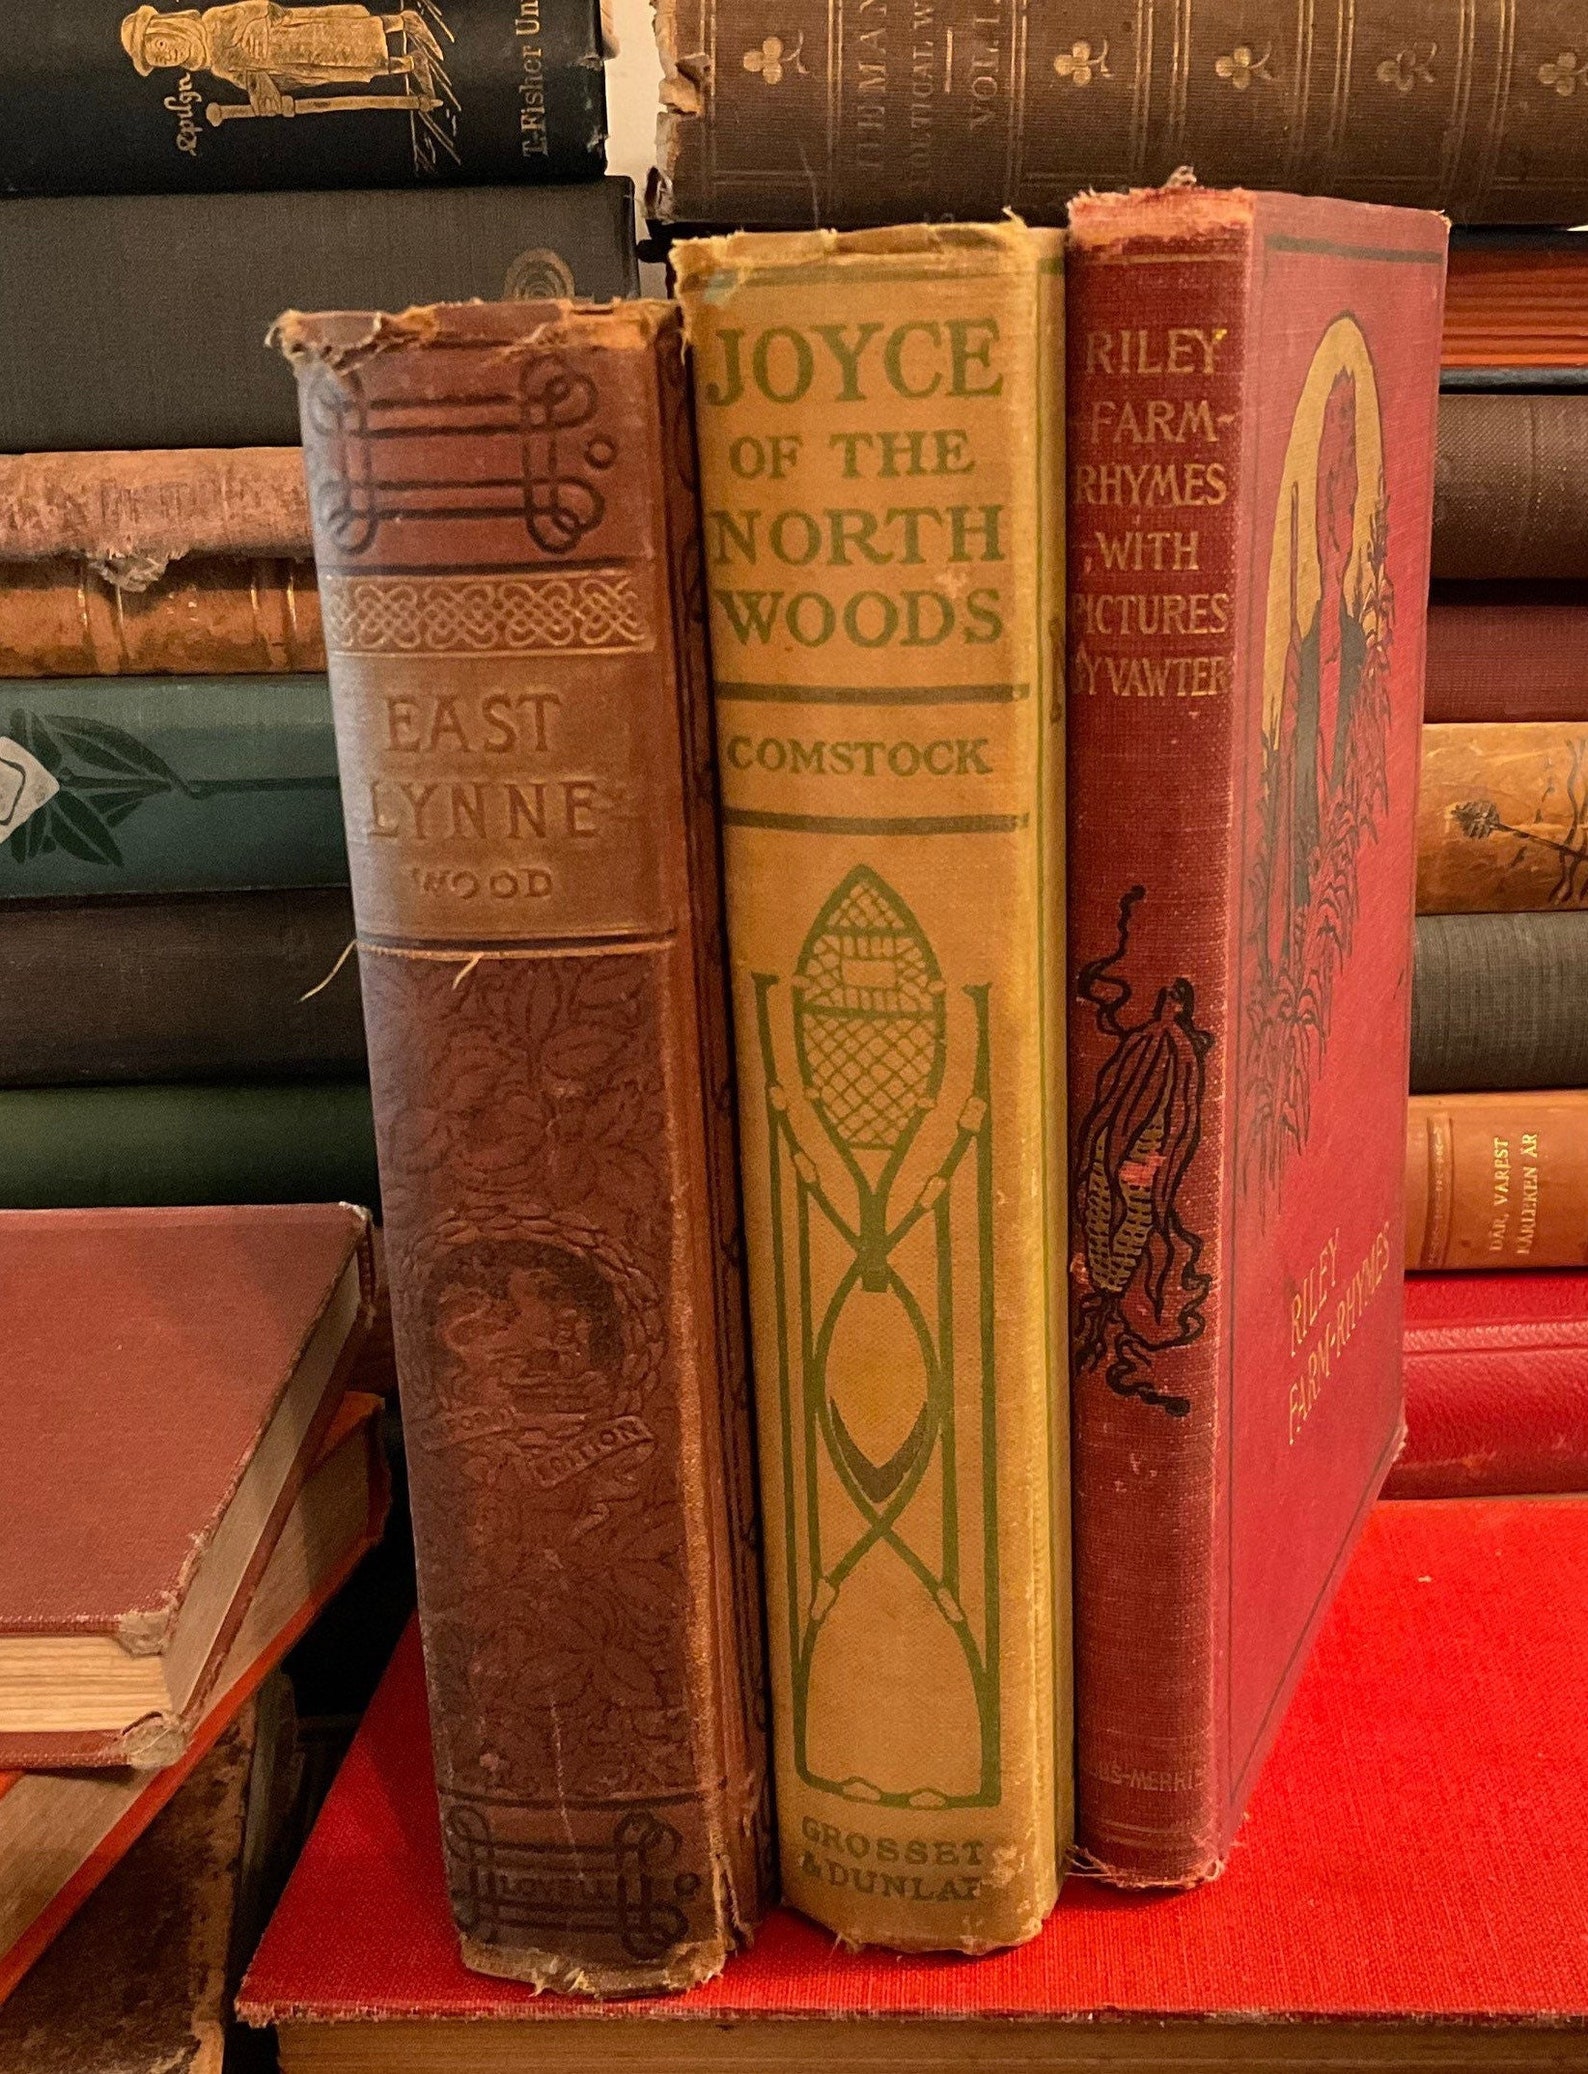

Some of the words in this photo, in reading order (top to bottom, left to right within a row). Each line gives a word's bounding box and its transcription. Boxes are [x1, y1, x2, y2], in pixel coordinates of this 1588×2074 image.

[518, 44, 547, 132] Fisher
[704, 318, 1004, 406] JOYCE
[1085, 328, 1228, 376] RILEY
[1090, 399, 1236, 444] FARM-
[729, 434, 802, 480] OF
[829, 429, 976, 479] THE
[1075, 463, 1228, 507] RHYMES
[709, 504, 1006, 567] NORTH
[1095, 531, 1200, 572] WITH
[712, 587, 1004, 649] WOODS
[384, 692, 563, 754] EAST
[727, 735, 993, 777] COMSTOCK
[366, 779, 601, 841] LYNNE
[411, 867, 554, 900] WOOD
[1493, 1136, 1512, 1206] VAREST
[1289, 1226, 1341, 1359] RILEY
[1288, 1222, 1391, 1447] FARM-RHYMES
[533, 1419, 642, 1482] EDITION
[801, 1814, 986, 1867] GROSSET
